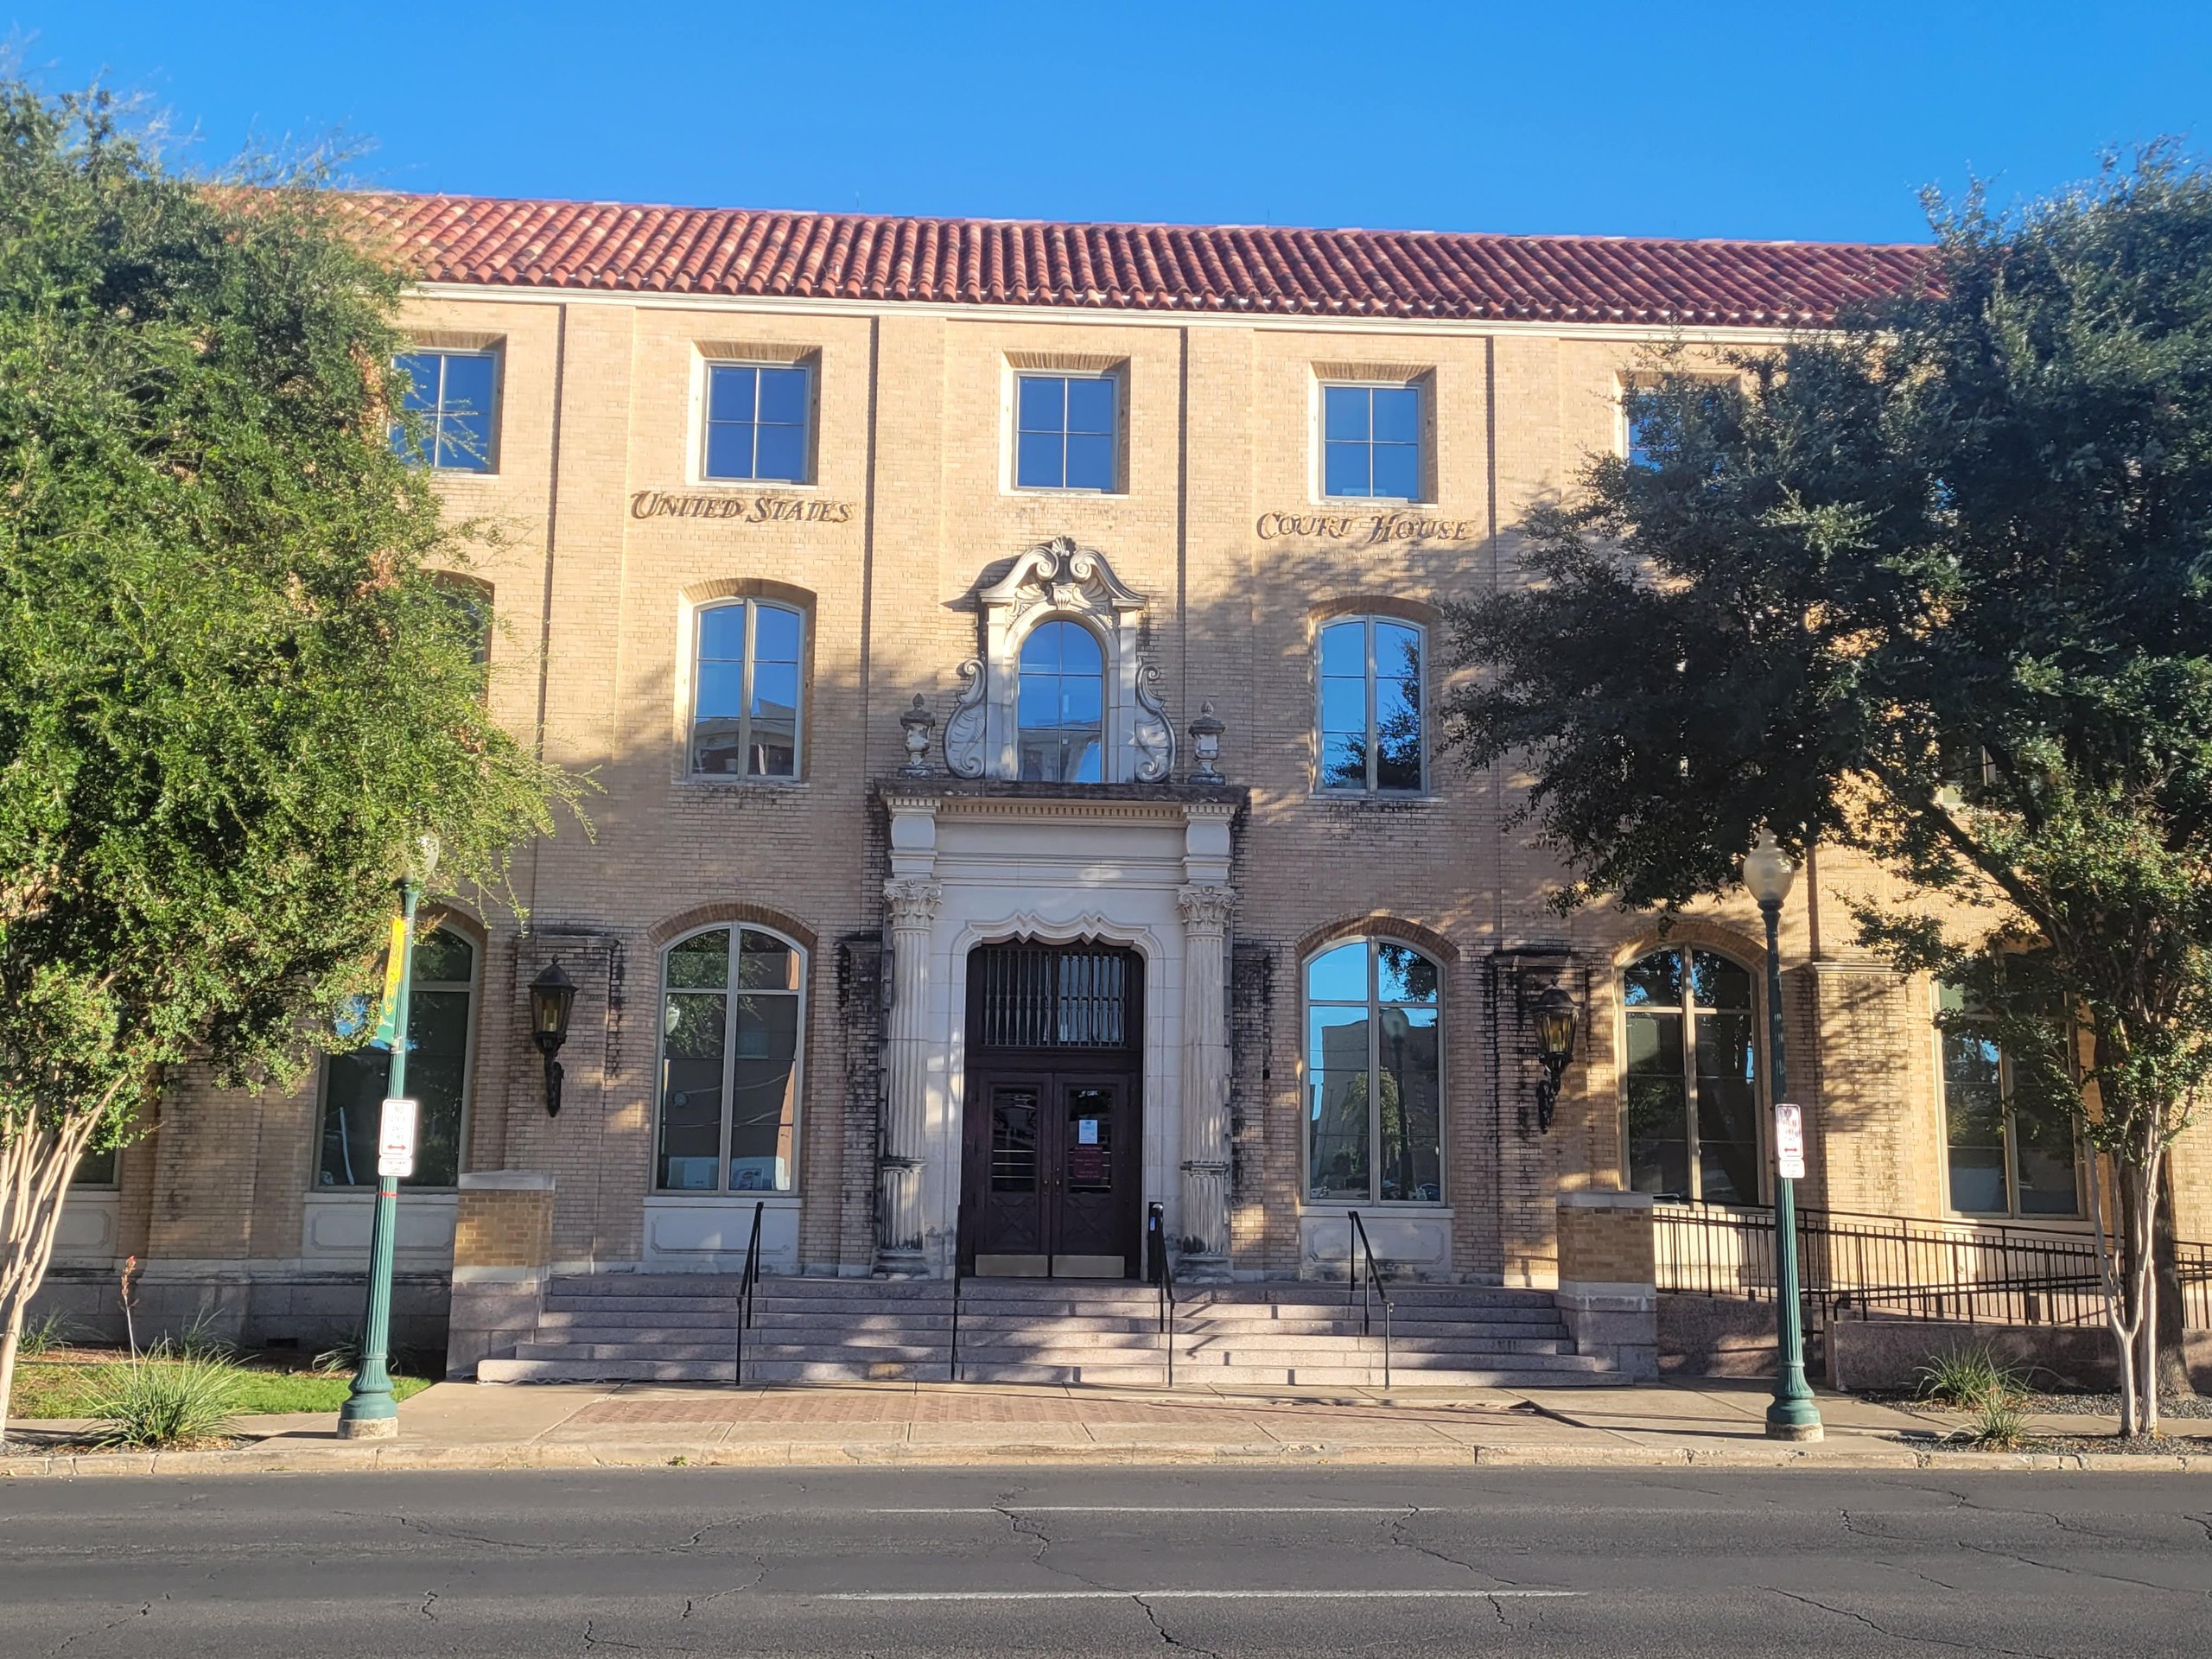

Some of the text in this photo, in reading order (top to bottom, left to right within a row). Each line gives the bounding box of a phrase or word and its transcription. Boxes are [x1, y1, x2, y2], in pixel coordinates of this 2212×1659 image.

[631, 491, 856, 523] UNITED STATES
[1256, 511, 1476, 543] COURT HOUSE
